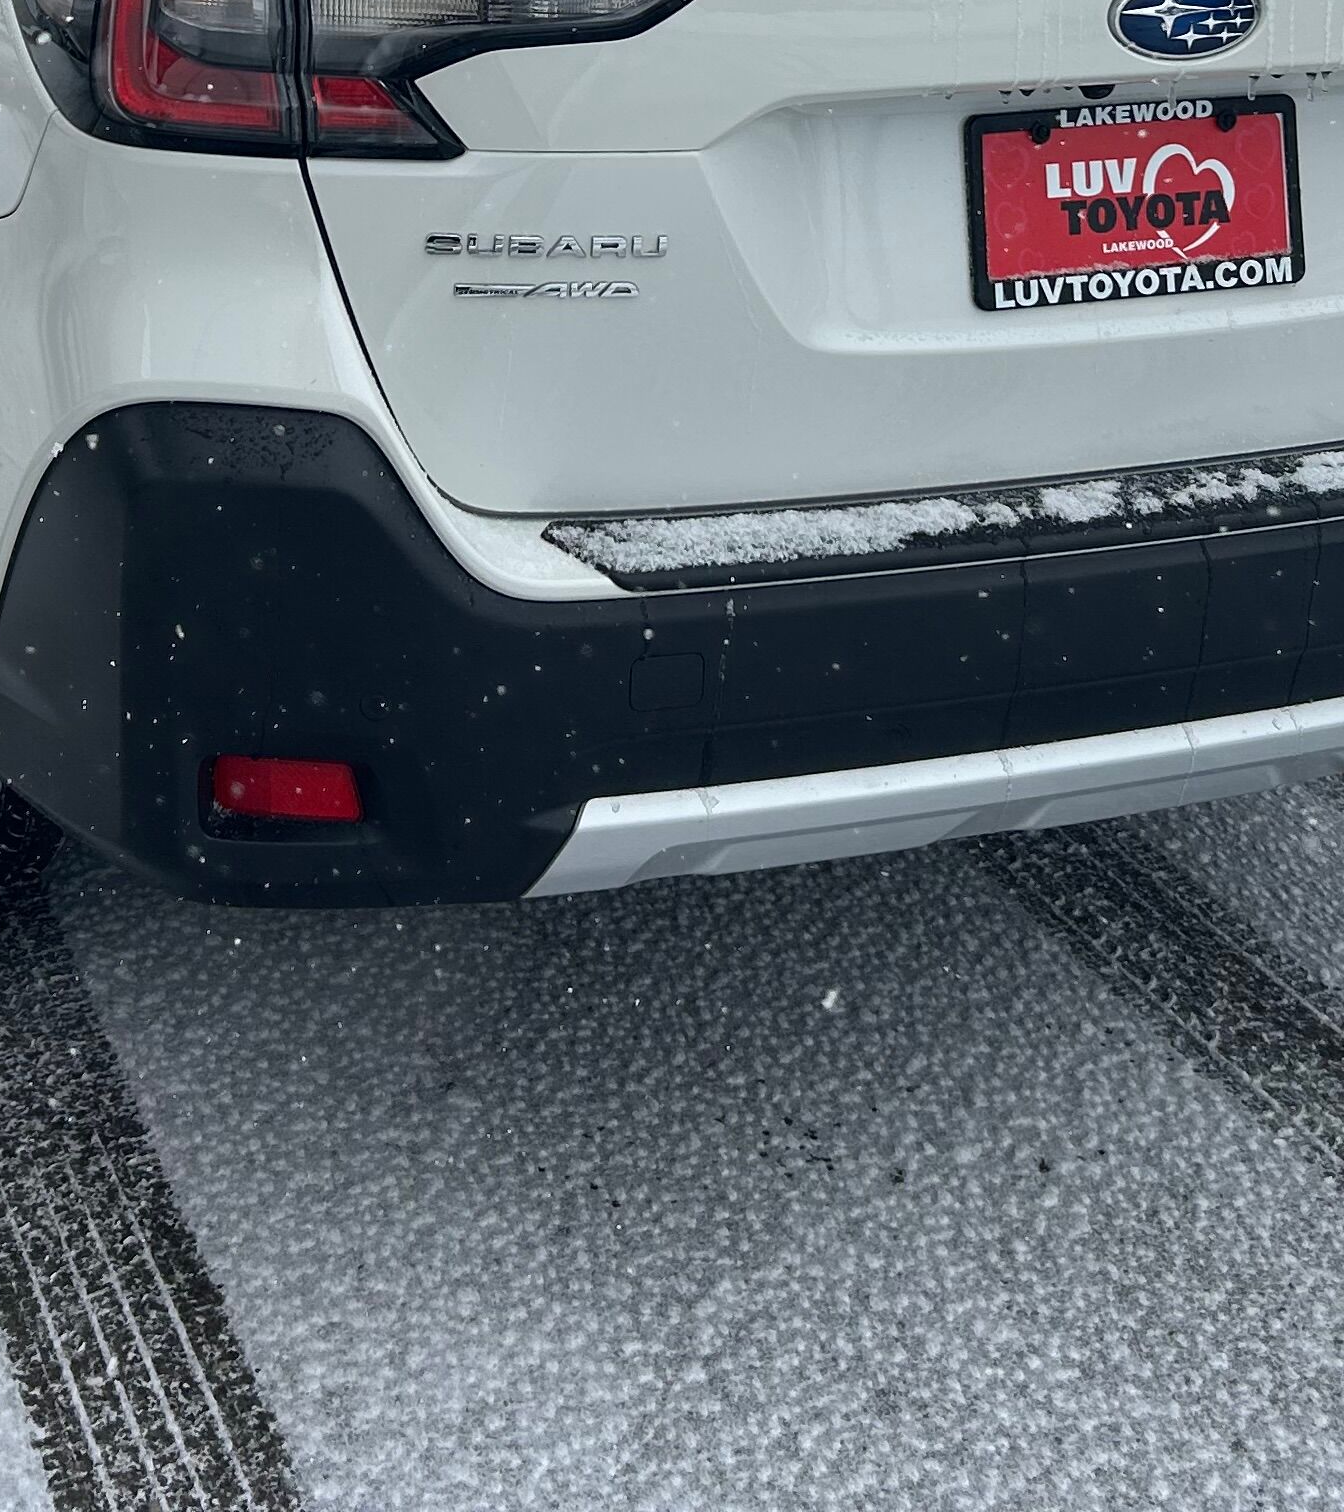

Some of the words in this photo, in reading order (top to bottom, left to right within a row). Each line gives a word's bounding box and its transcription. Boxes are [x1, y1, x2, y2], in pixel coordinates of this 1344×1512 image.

[1058, 99, 1214, 128] LAKEWOOD
[1044, 157, 1137, 199] LUV
[1061, 190, 1231, 236] TOYOTA
[424, 233, 669, 258] SUBARU
[1102, 237, 1174, 254] LAKEWOOD
[523, 281, 640, 298] AWD
[994, 256, 1293, 310] LUVTOYOTA.COM
